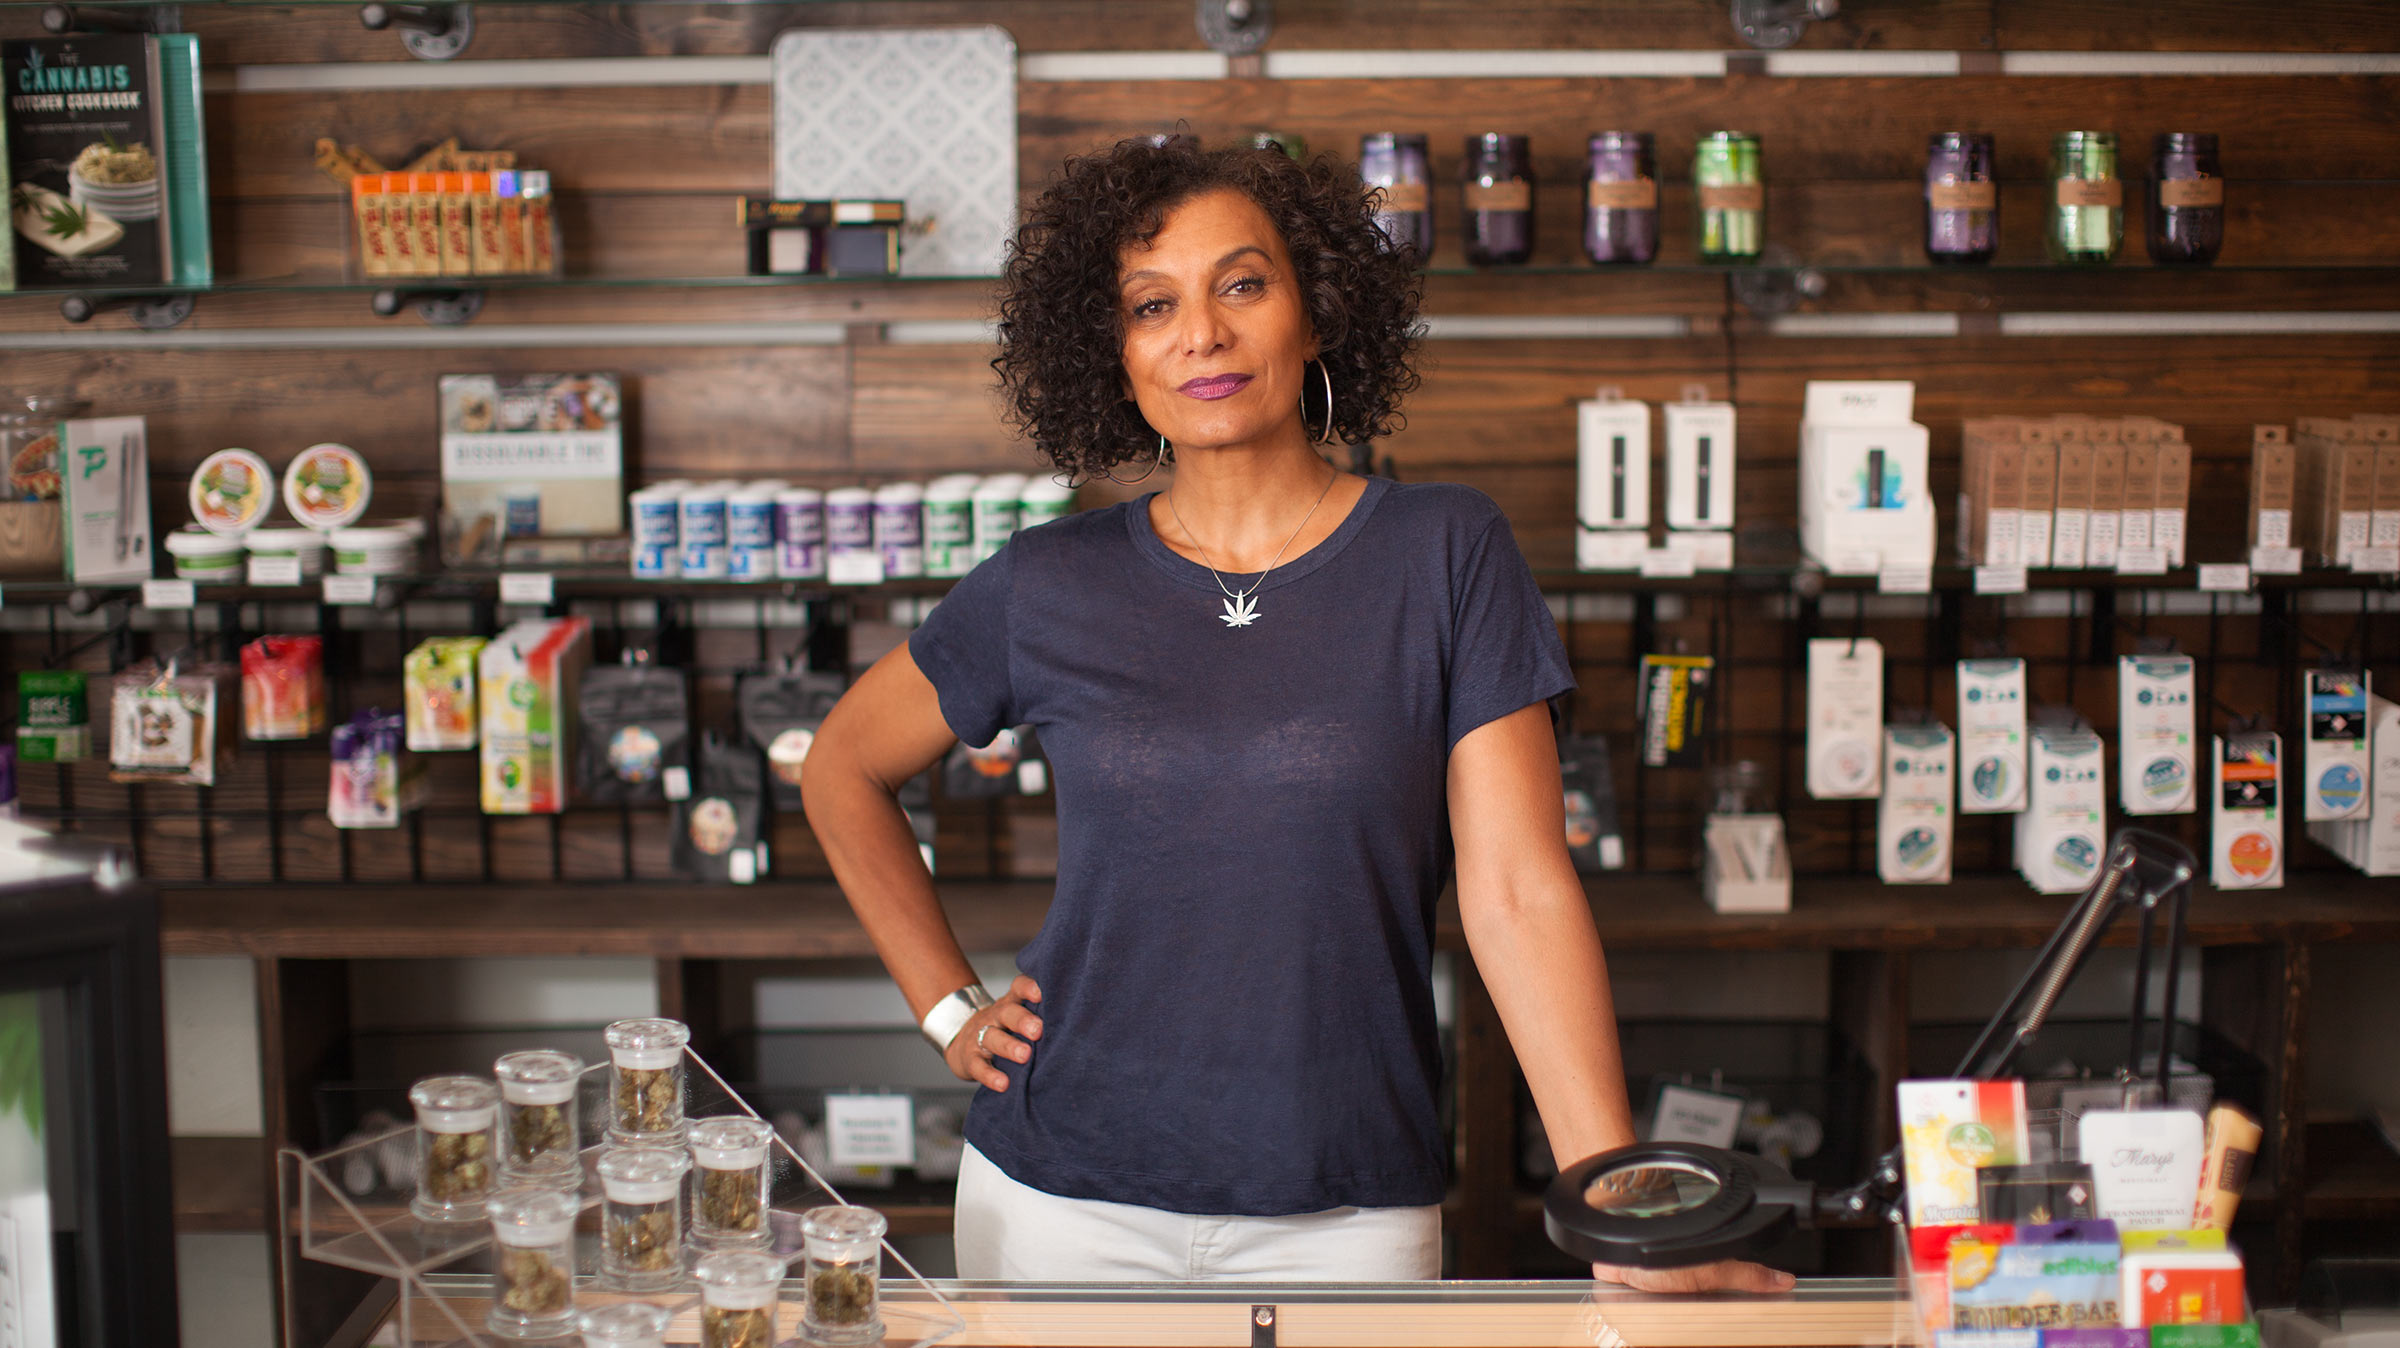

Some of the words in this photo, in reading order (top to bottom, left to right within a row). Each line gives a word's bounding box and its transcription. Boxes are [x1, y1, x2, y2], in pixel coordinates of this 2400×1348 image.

[20, 65, 130, 92] CANNABIS
[13, 93, 64, 112] KITCHEN
[66, 91, 140, 110] COOKBOOK
[2219, 1150, 2240, 1189] CLASSIC
[2073, 1301, 2121, 1322] BAR
